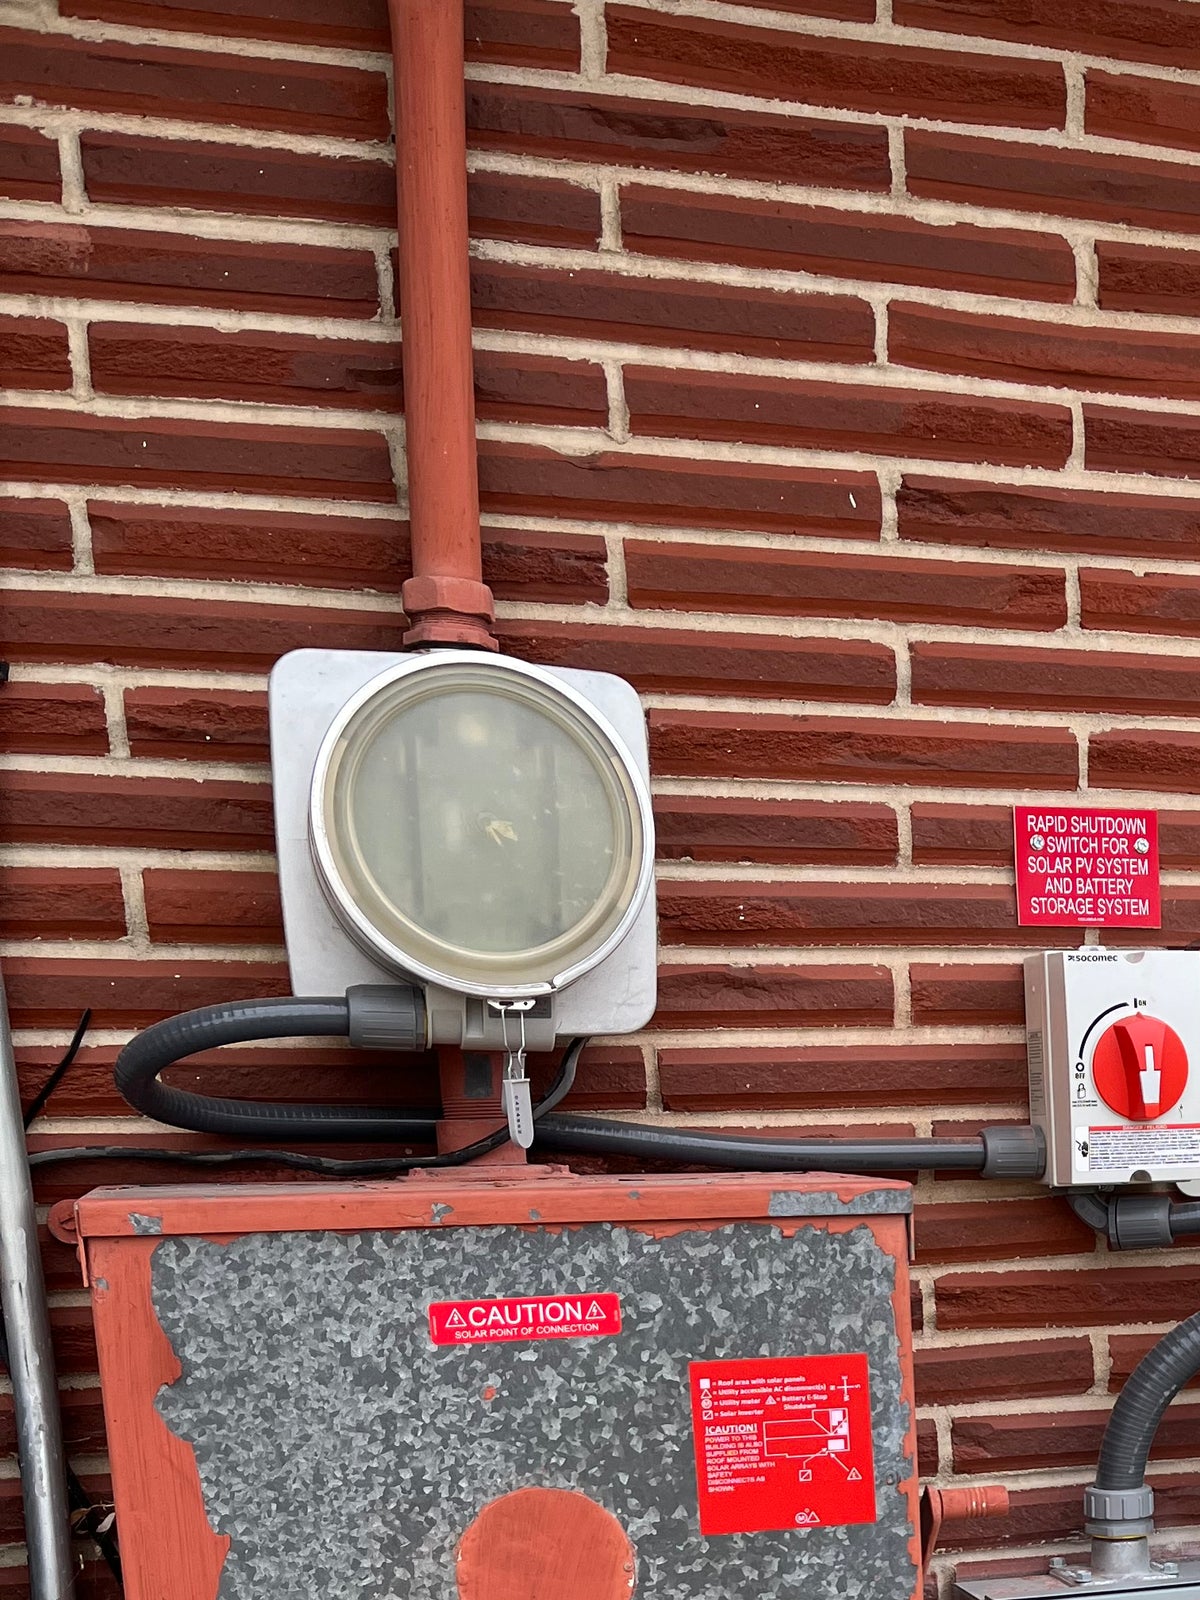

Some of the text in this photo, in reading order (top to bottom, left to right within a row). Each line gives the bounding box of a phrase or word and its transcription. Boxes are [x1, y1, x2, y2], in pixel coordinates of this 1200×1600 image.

[1027, 815, 1146, 835] RAPID SHUTDOWN
[1046, 836, 1129, 854] SWITCH FOR
[1028, 856, 1148, 875] SOLAR PV SYSTEM
[1045, 877, 1133, 895] AND BATTERY
[1030, 897, 1149, 915] STORAGE SYSTEM
[1076, 954, 1118, 962] socomec
[468, 1301, 582, 1327] CAUTION
[454, 1323, 599, 1339] SOLAR POINT OF CONNECTION
